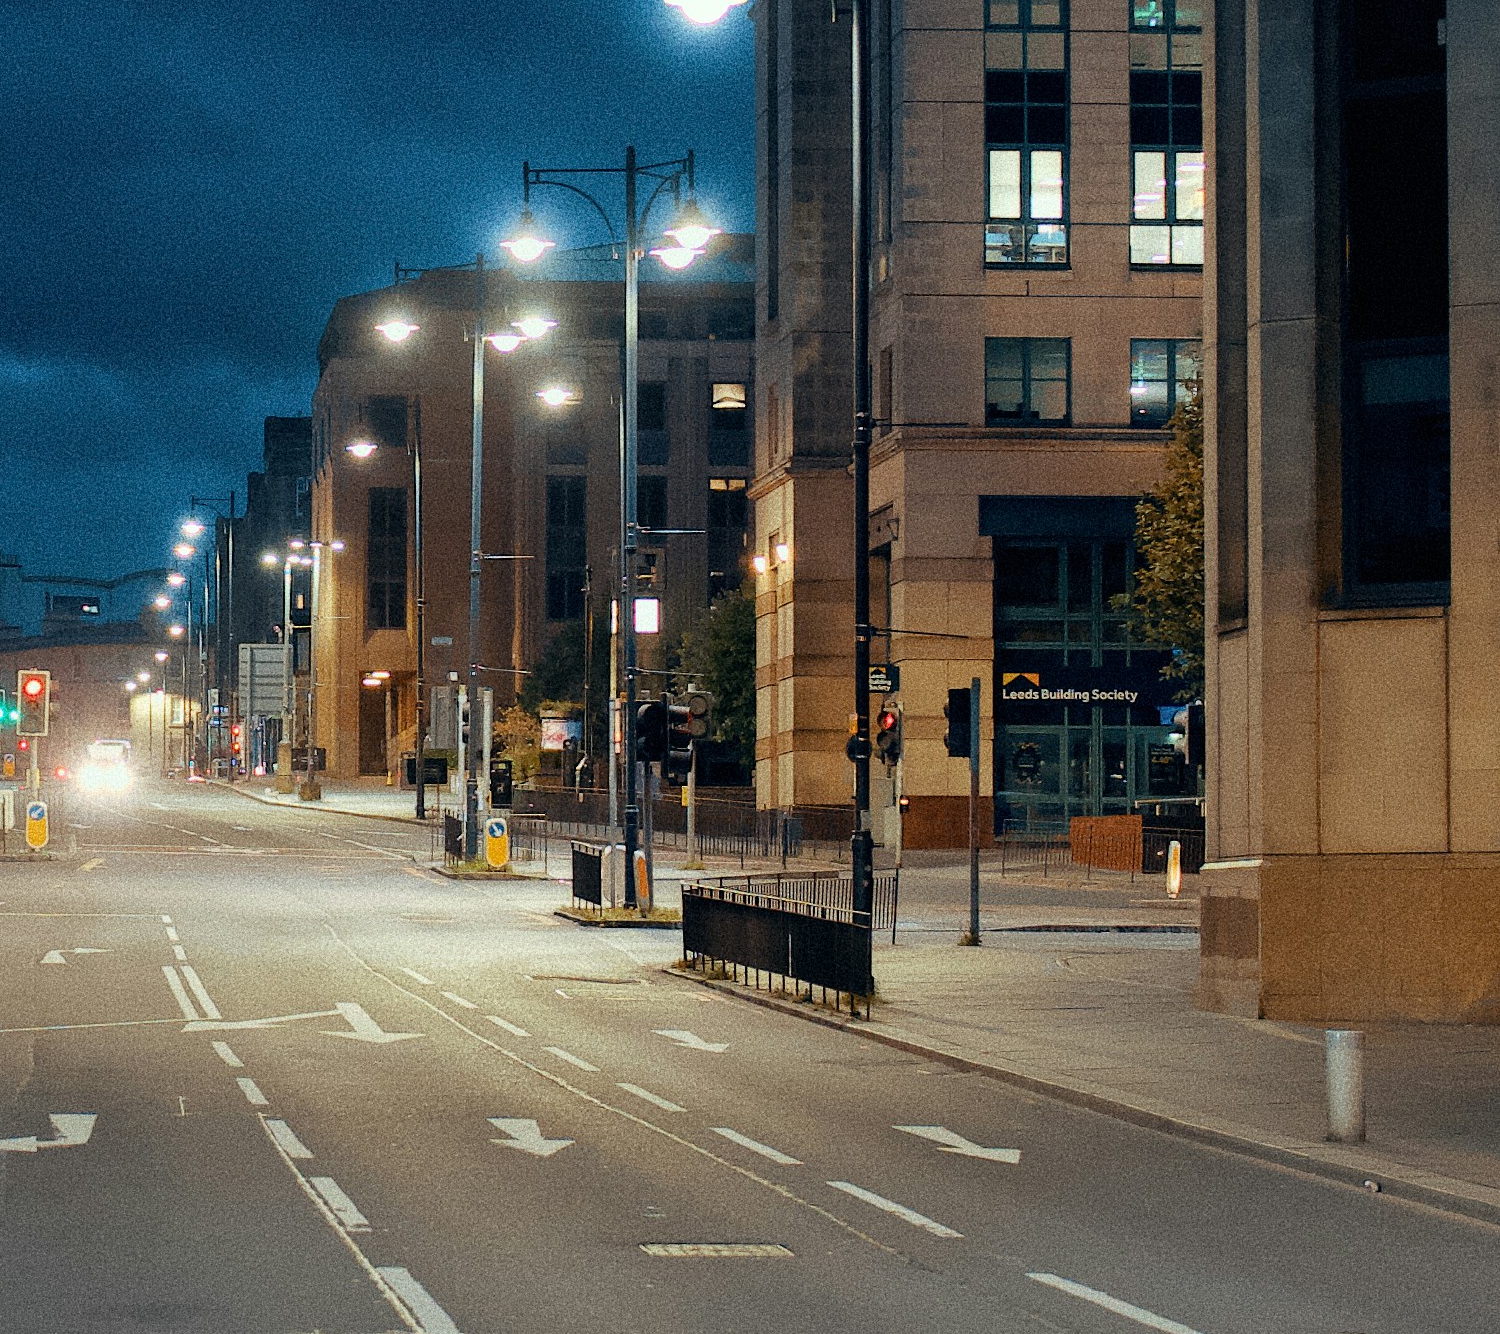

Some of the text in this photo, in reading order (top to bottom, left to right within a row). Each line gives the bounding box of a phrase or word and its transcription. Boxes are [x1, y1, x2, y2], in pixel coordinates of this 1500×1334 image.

[1002, 688, 1139, 703] Leeds Building Society
